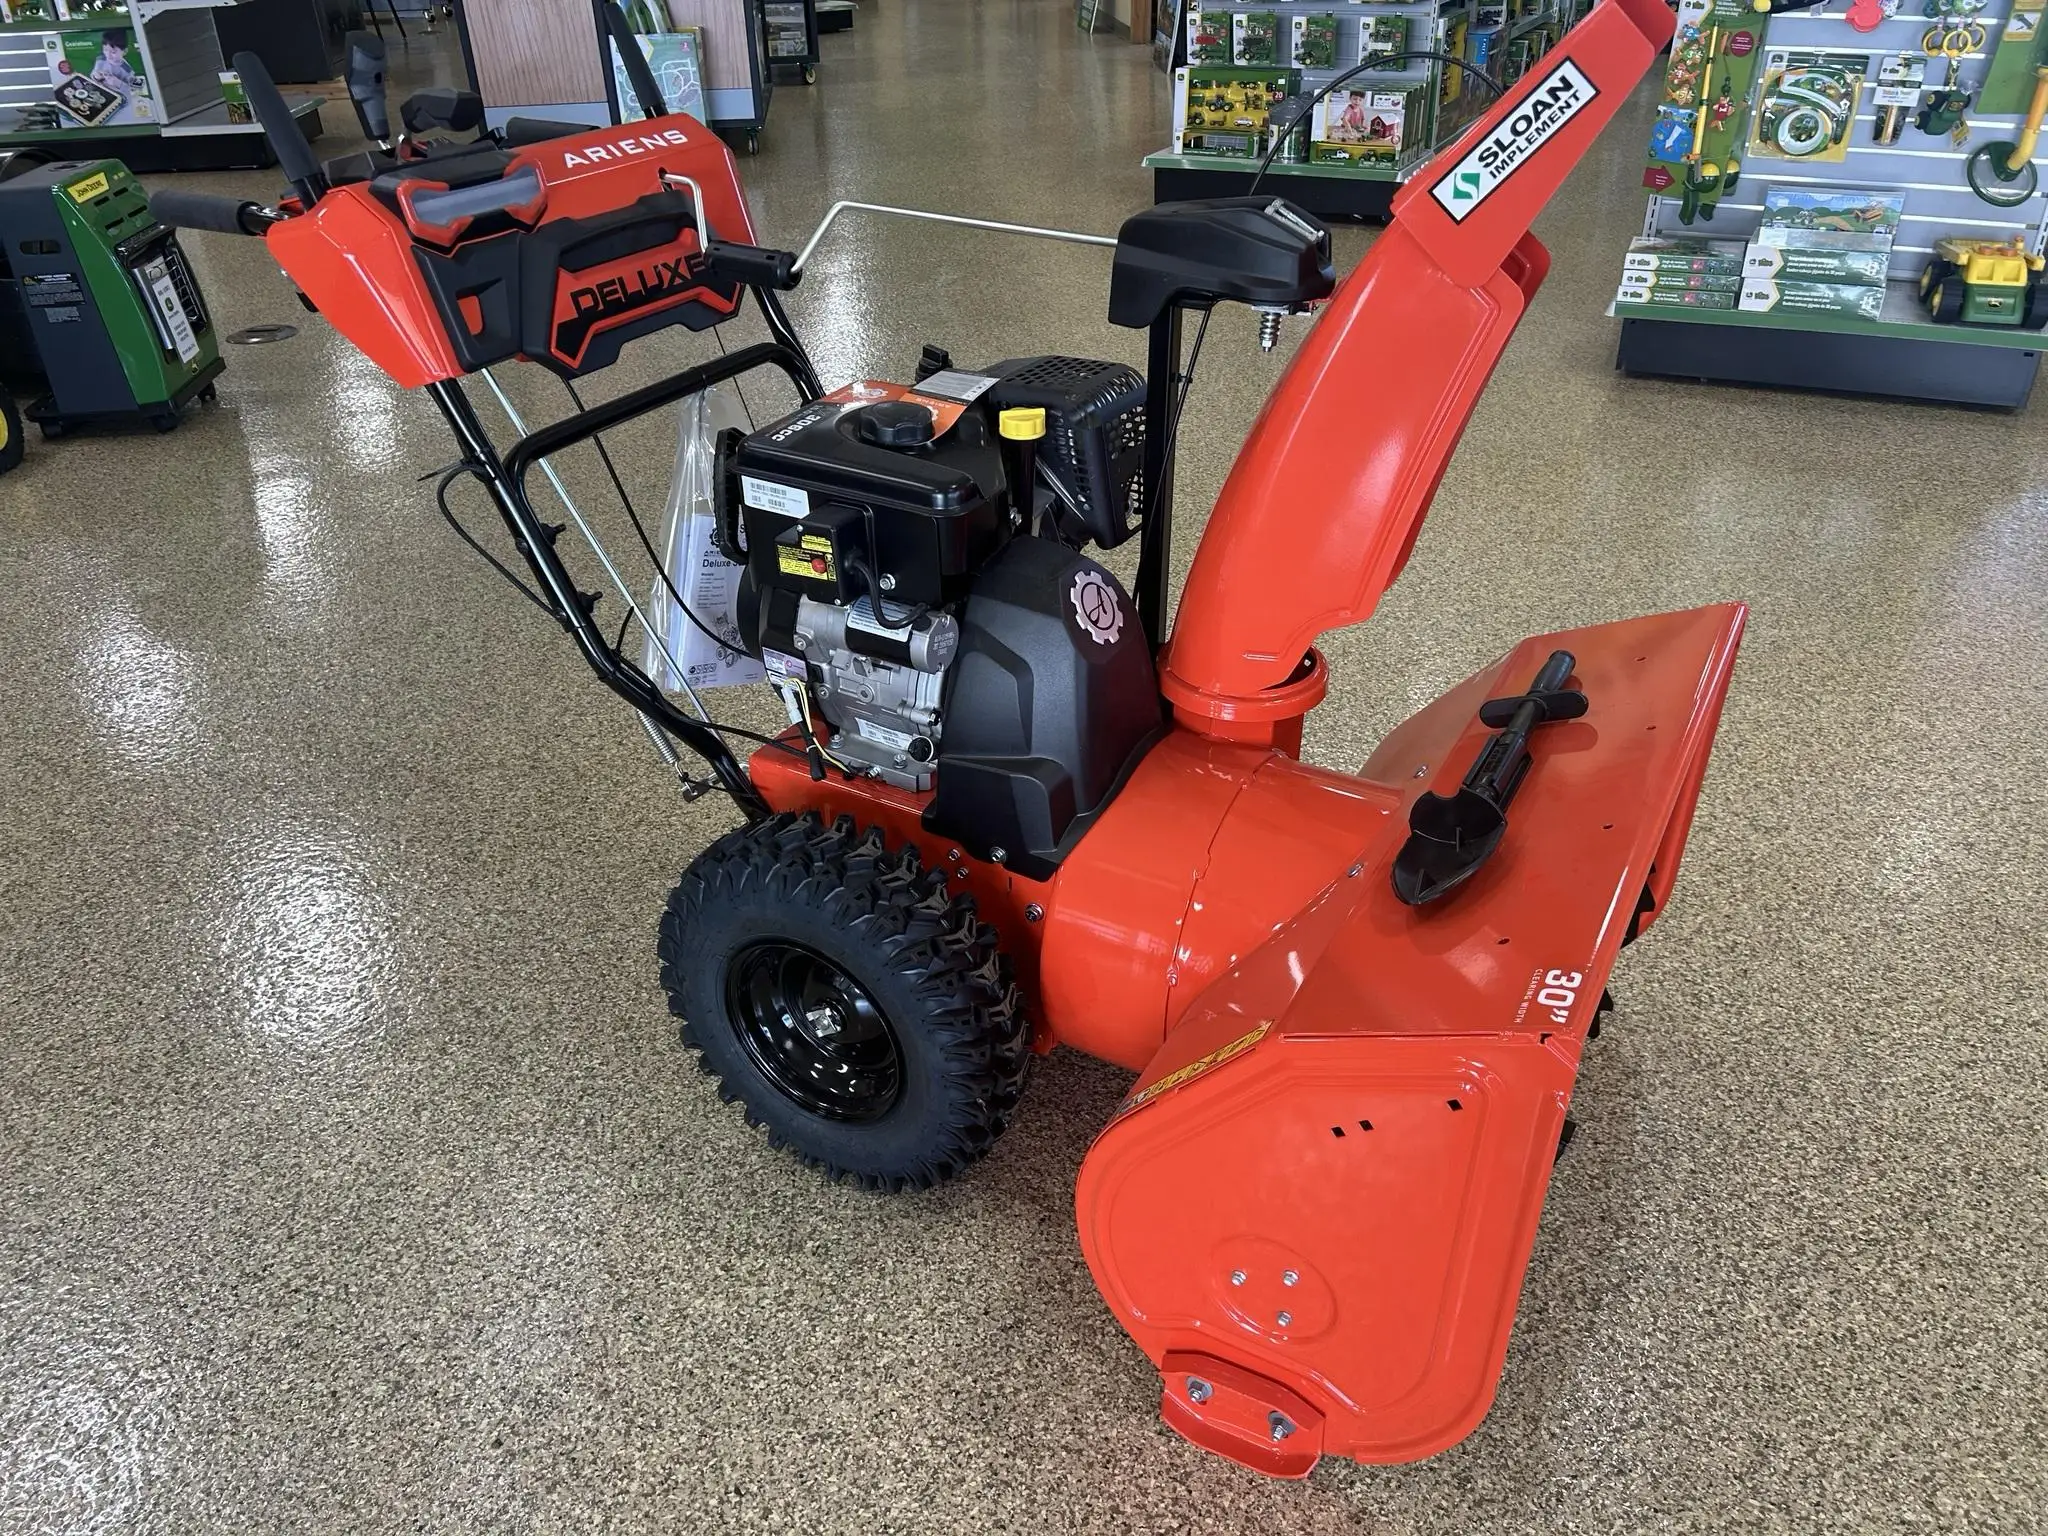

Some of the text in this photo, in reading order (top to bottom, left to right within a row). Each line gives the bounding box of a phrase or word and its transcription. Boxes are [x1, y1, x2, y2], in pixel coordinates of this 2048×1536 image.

[1275, 91, 1284, 99] 20
[1477, 75, 1574, 169] SLOAN
[1489, 89, 1581, 180] IMPLEMENT
[564, 129, 689, 169] ARIENS
[570, 251, 706, 318] DELUXE
[771, 414, 822, 442] 306cc
[702, 558, 732, 568] Deluxe
[1513, 968, 1543, 1023] CLEARING WIDTH
